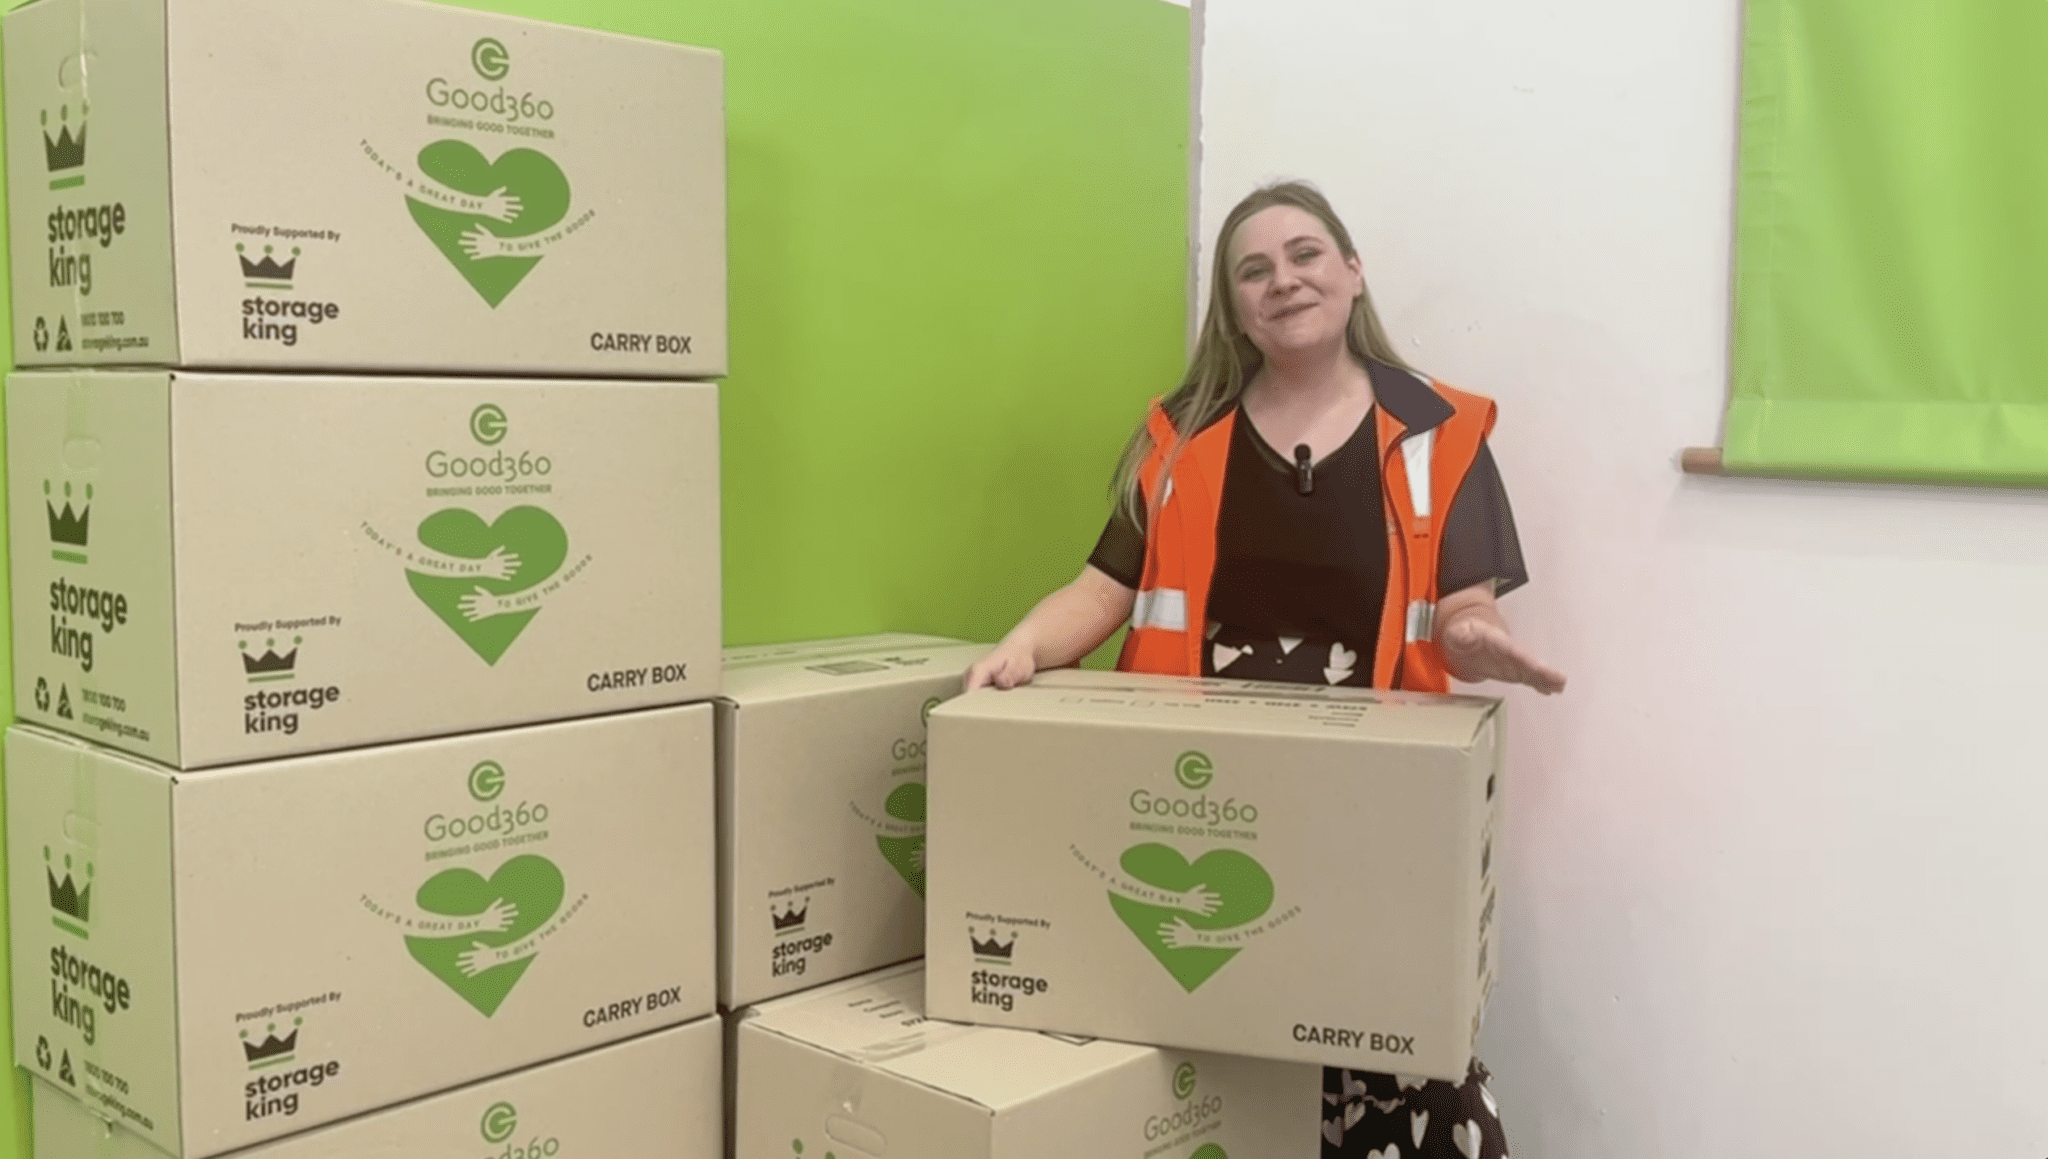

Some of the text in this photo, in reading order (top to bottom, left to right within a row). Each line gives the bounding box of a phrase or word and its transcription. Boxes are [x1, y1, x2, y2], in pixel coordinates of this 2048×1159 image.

[426, 77, 554, 122] Good360
[427, 114, 555, 139] BRINGING GOOD TOGETHER
[360, 138, 483, 210] TODAY'S A GREAT DAY
[48, 202, 126, 248] storage
[231, 223, 341, 243] Proudly Supported By
[500, 208, 596, 251] TO GIVE THE GOODS
[49, 245, 92, 296] king
[242, 296, 340, 324] storage
[243, 316, 298, 346] king
[590, 332, 692, 354] CARRY BOX
[425, 449, 552, 482] Good360
[426, 484, 552, 498] BRINGING GOOD TOGETHER
[360, 521, 481, 572] TODAY'S A GREAT DAY
[50, 576, 128, 633] storage
[498, 599, 511, 608] TO
[516, 593, 539, 606] GIVE
[542, 581, 560, 595] THE
[234, 615, 341, 632] Proudly Supported By
[51, 614, 94, 673] king
[587, 663, 687, 692] CARRY BOX
[244, 685, 340, 711] storage
[245, 710, 299, 735] king
[424, 800, 549, 842] Good360
[1129, 788, 1258, 827] Good360
[425, 830, 549, 862] BRINGING GOOD TOGETHER
[1129, 821, 1258, 840] BRINGING GOOD TOGETHER
[793, 880, 826, 893] Supported
[1069, 843, 1181, 904] TODAY'S A GREAT DAY
[360, 894, 480, 931] TODAY'S A GREAT DAY
[966, 911, 1051, 930] Proudly Supported By
[495, 950, 508, 959] TO
[539, 925, 557, 941] THE
[772, 932, 833, 959] storage
[1197, 933, 1211, 942] TO
[1245, 925, 1264, 938] THE
[50, 944, 131, 1014] storage
[772, 957, 806, 977] king
[971, 969, 1048, 996] storage
[51, 978, 95, 1046] king
[236, 991, 342, 1023] Proudly Supported By
[582, 986, 682, 1029] CARRY BOX
[971, 985, 1014, 1012] king
[1292, 1023, 1415, 1056] CARRY BOX
[245, 1060, 340, 1098] storage
[246, 1093, 299, 1121] king
[1144, 1095, 1222, 1141] Good360
